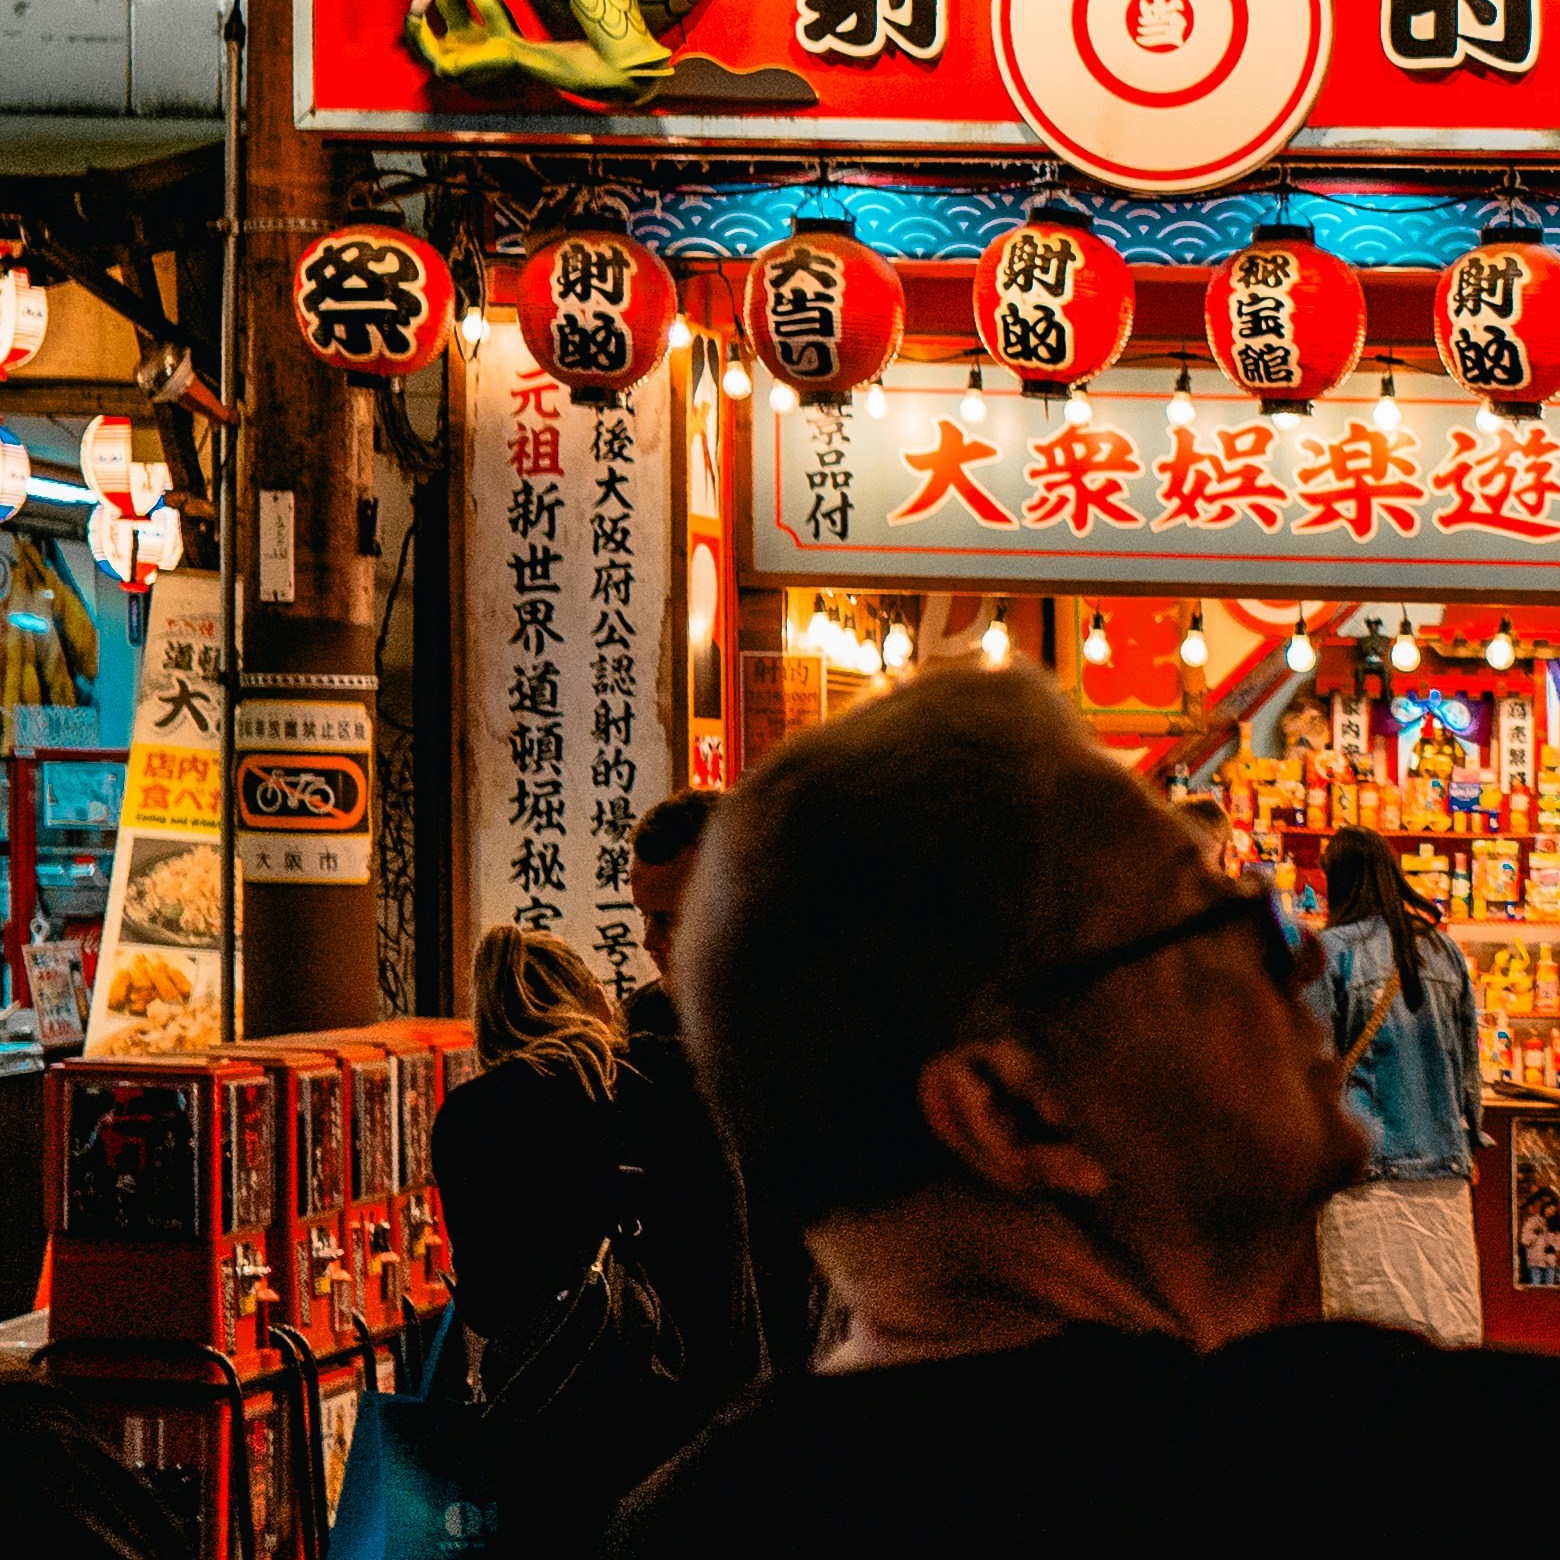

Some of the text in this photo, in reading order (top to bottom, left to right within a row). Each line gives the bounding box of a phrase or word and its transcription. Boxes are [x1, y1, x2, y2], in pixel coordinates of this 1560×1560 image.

[301, 241, 424, 359] 祭
[769, 244, 841, 378] 大当り
[1234, 252, 1298, 386] 秘宝館
[590, 395, 638, 1002] 後大阪府公認射的場第一号
